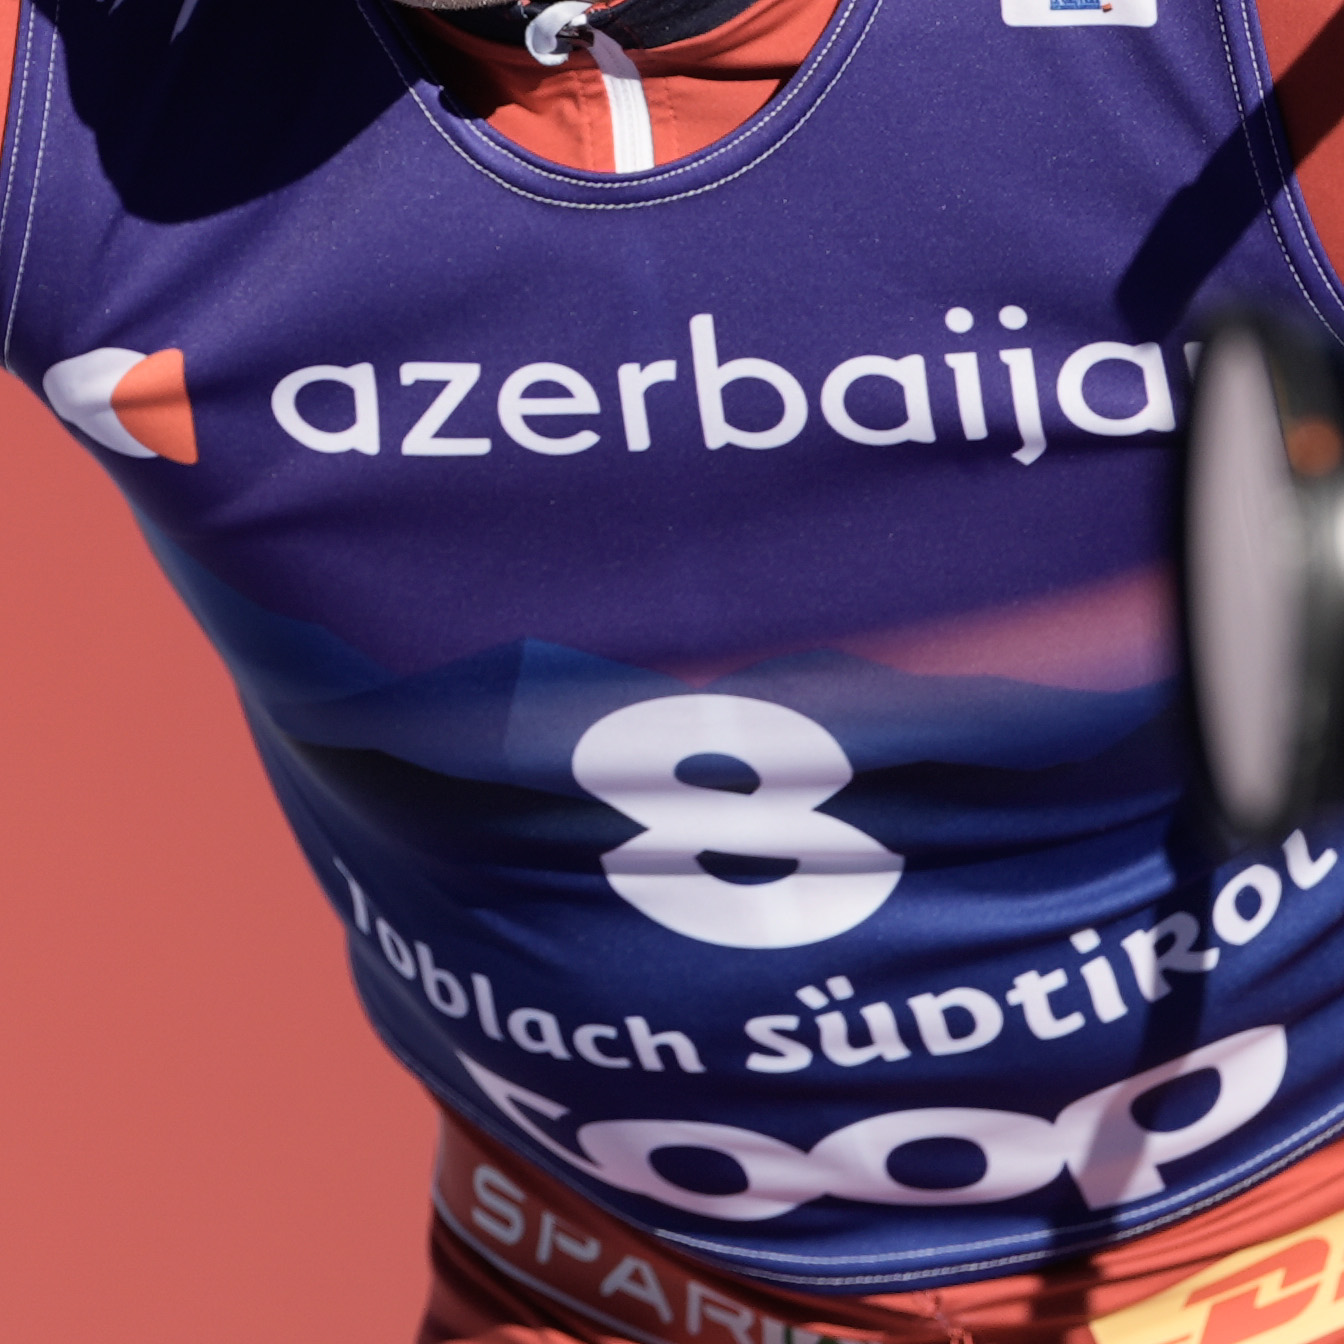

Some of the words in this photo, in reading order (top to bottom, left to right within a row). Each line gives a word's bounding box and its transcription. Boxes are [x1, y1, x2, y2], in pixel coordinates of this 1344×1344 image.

[270, 305, 1202, 466] azerbaija
[572, 694, 905, 949] 8
[456, 1025, 1288, 1222] coop
